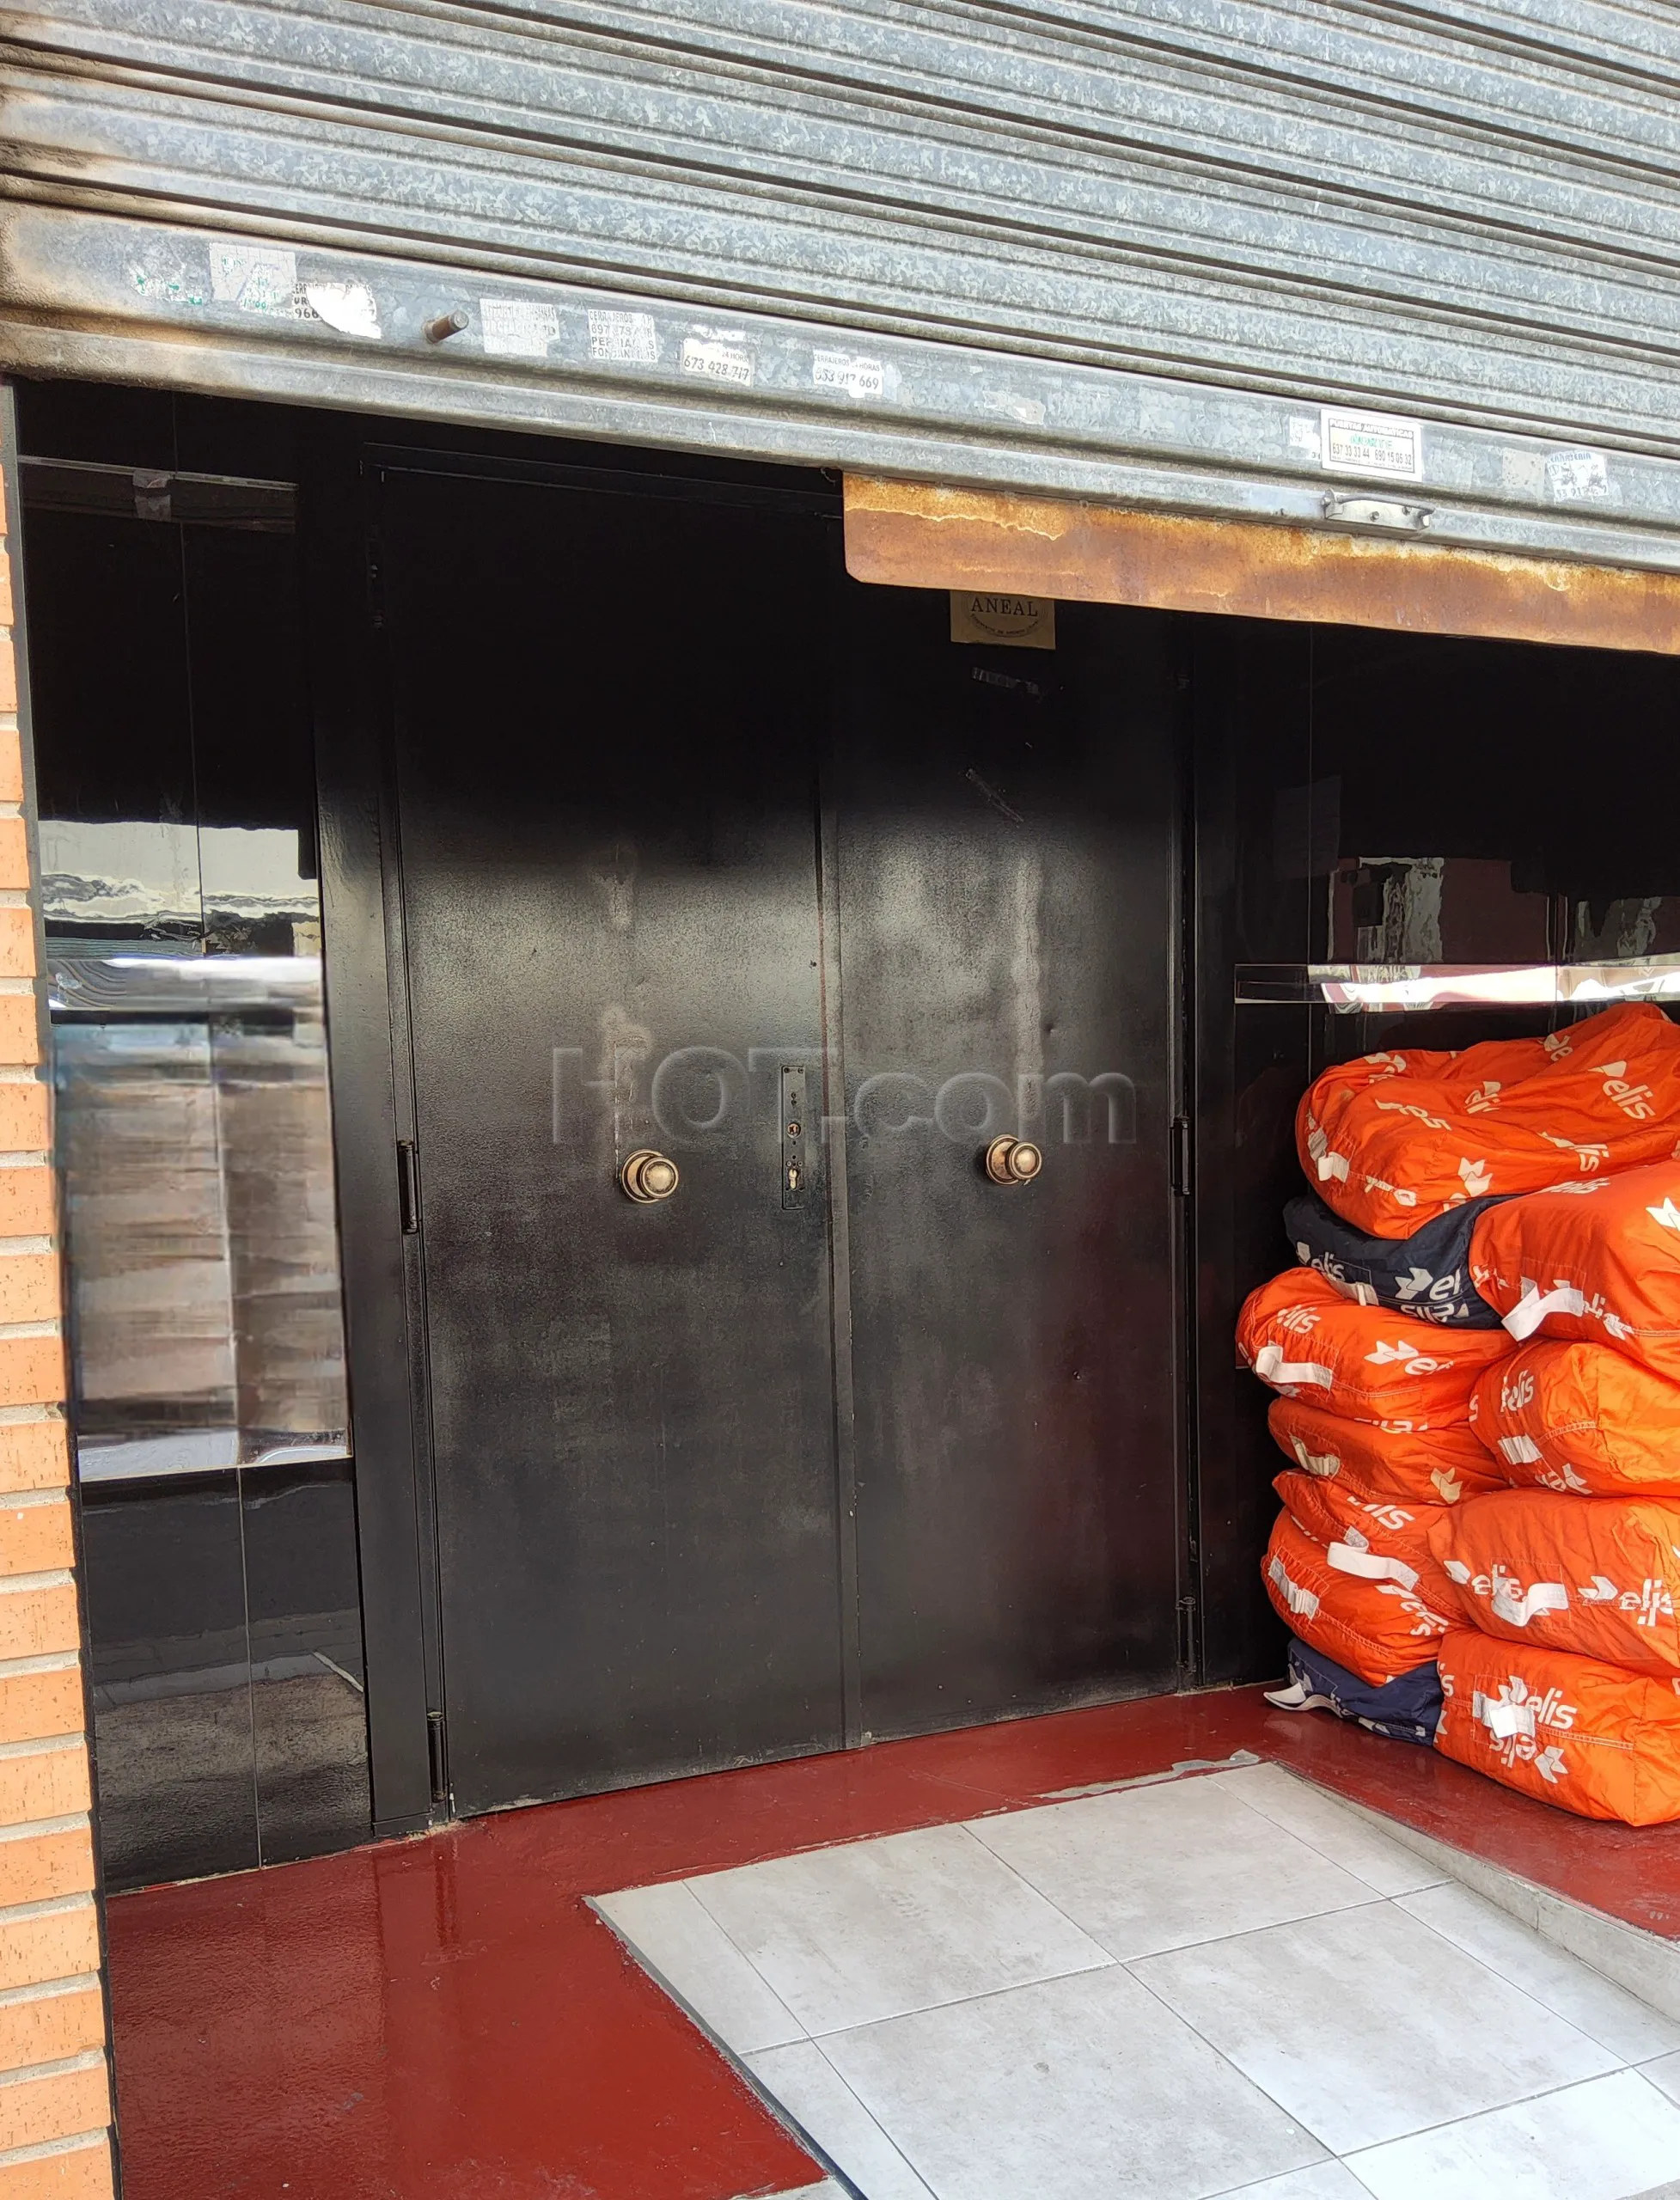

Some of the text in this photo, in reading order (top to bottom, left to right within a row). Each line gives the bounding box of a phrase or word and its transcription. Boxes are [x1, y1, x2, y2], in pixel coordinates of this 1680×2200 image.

[683, 355, 705, 370] 673
[708, 361, 729, 376] 428
[730, 352, 749, 363] HORA
[858, 362, 881, 372] HORAS
[858, 375, 879, 390] 669
[1329, 419, 1362, 431] PUERTAS
[1351, 433, 1393, 449] NORTE
[1332, 443, 1343, 455] 637
[1345, 445, 1353, 457] 33
[1353, 446, 1361, 459] 33
[1362, 447, 1370, 459] 44
[1374, 449, 1386, 461] 690
[1387, 451, 1395, 464] 15
[1396, 453, 1403, 465] 05
[1404, 454, 1412, 466] 32
[970, 597, 1038, 617] ANEAL
[1602, 1079, 1656, 1120] elis
[1310, 1251, 1347, 1282] elis
[1524, 1687, 1579, 1730] elis
